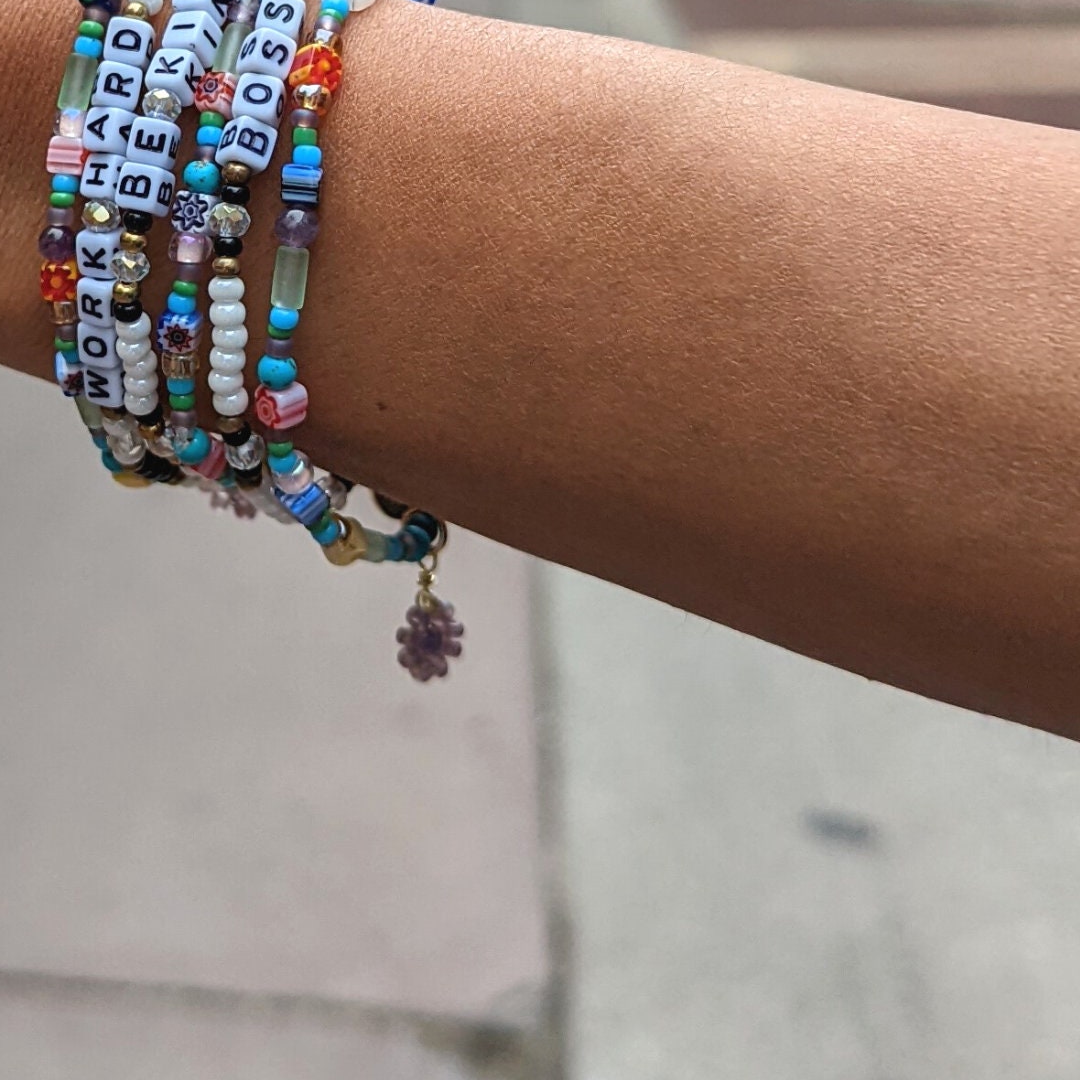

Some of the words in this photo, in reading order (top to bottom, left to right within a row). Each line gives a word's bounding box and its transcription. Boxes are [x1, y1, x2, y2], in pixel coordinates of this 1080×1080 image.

[86, 28, 142, 186] HARD
[237, 1, 295, 157] BOSS
[119, 128, 166, 198] BE
[81, 247, 110, 399] WORK
